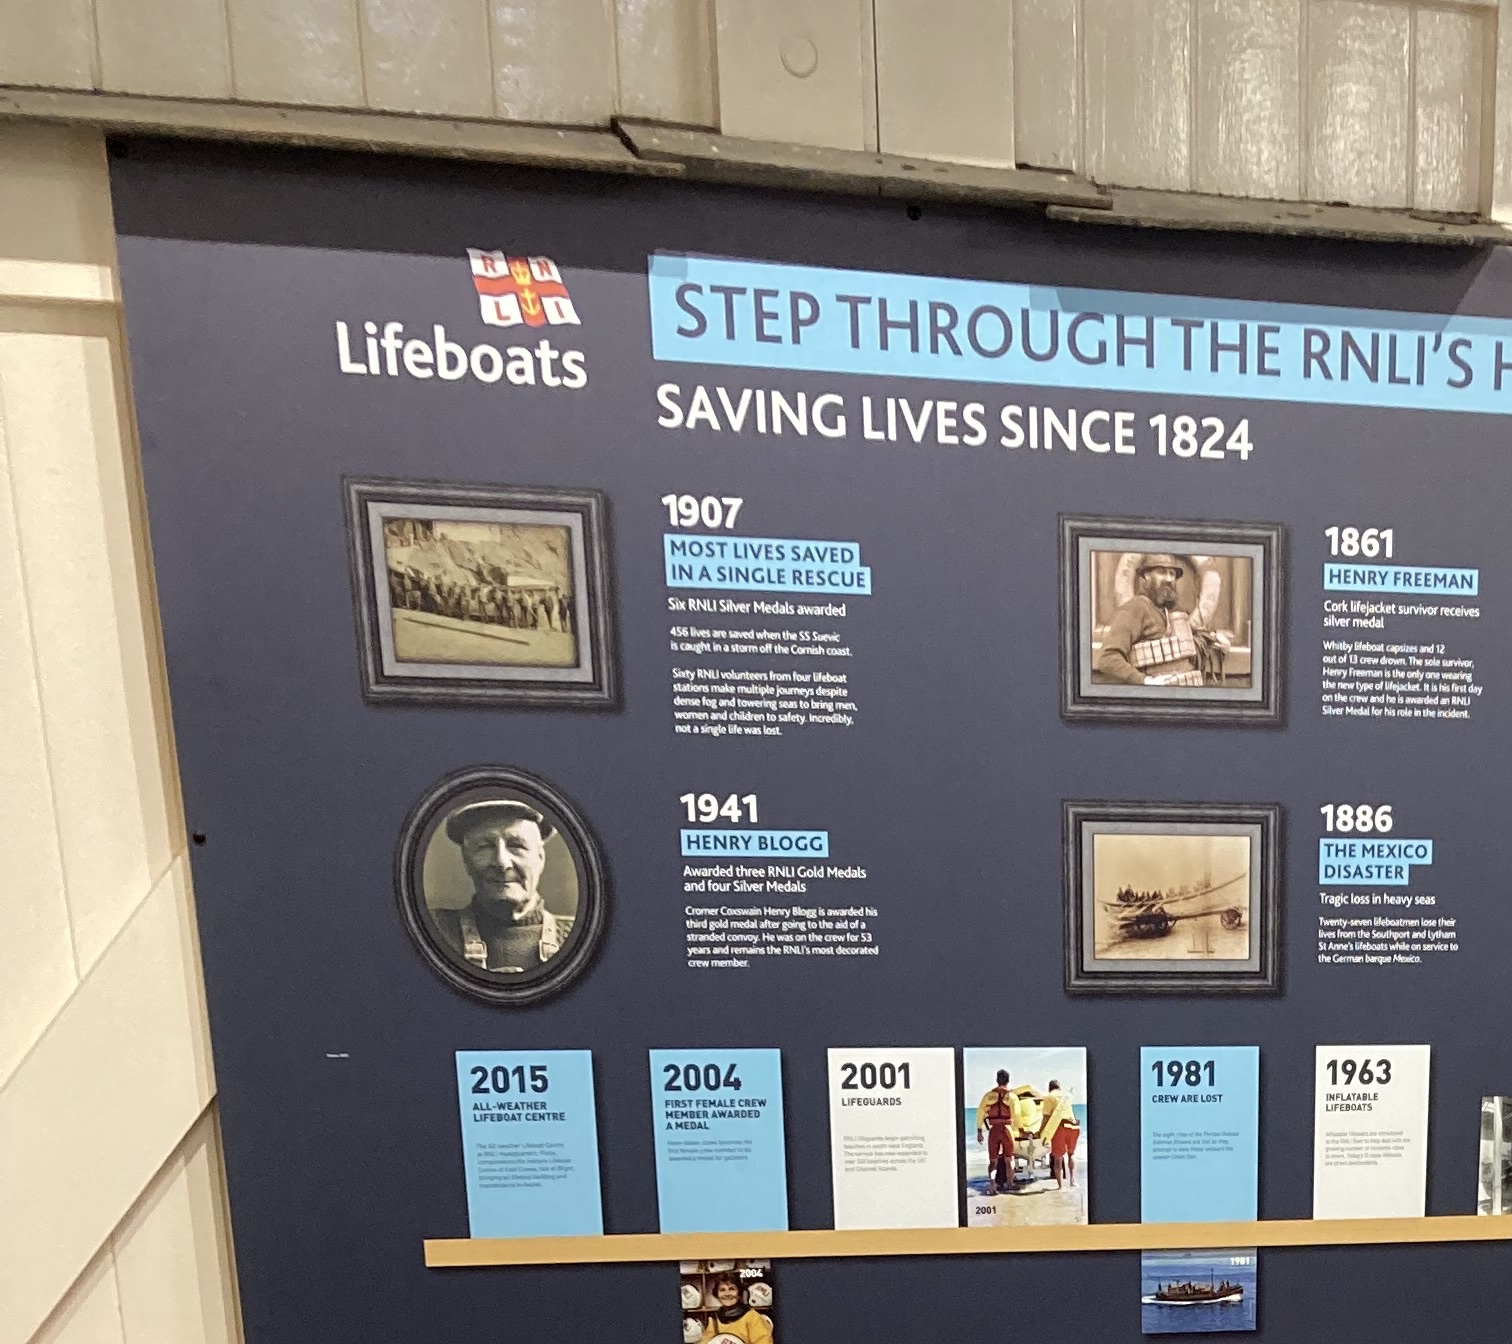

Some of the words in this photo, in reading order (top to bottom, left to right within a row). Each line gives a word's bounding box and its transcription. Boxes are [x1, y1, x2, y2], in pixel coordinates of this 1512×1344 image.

[481, 255, 497, 273] R
[537, 260, 552, 277] N
[495, 301, 511, 321] L
[556, 301, 565, 319] I
[675, 283, 821, 345] STEP
[836, 294, 1156, 370] THROUGH
[1172, 317, 1282, 377] THE
[1301, 327, 1474, 389] RNLI'S
[335, 320, 588, 389] Lifeboats
[655, 383, 846, 439] SAVING
[862, 395, 987, 447] LIVES
[1000, 405, 1136, 455] SINCE
[1149, 414, 1254, 461] 1824
[661, 494, 743, 529] 1907
[1325, 526, 1393, 558] 1861
[670, 540, 728, 558] MOST
[734, 542, 785, 561] LIVES
[791, 547, 854, 564] SAVED
[672, 564, 693, 580] IN
[700, 566, 712, 582] A
[717, 567, 786, 585] SINGLE
[792, 570, 865, 588] RESCUE
[1330, 569, 1389, 586] HENRY
[1394, 571, 1473, 589] FREEMAN
[668, 597, 686, 611] Six
[689, 599, 717, 613] RNLI
[719, 599, 750, 614] Silver
[754, 601, 794, 615] Medals
[797, 603, 846, 617] awarded
[1324, 600, 1348, 613] Cork
[1351, 601, 1396, 616] lifejacket
[1399, 604, 1438, 616] survivor
[1440, 605, 1480, 617] receives
[1324, 616, 1350, 627] silver
[1353, 617, 1384, 629] medal
[670, 627, 688, 637] 456
[691, 627, 710, 638] lives
[712, 631, 727, 639] are
[729, 629, 754, 640] saved
[756, 630, 780, 640] when
[783, 631, 797, 641] the
[799, 631, 810, 641] SS
[812, 632, 840, 642] Suevic
[1323, 640, 1351, 652] Whitby
[1354, 641, 1384, 652] lifeboat
[1386, 644, 1417, 655] capsizes
[1420, 644, 1434, 653] and
[1436, 644, 1445, 654] 12
[680, 793, 758, 823] 1941
[1320, 804, 1392, 832] 1886
[687, 835, 752, 850] HENRY
[759, 836, 823, 851] BLOGG
[1324, 843, 1356, 858] THE
[1362, 844, 1427, 859] MEXICO
[684, 865, 733, 877] Awarded
[736, 865, 765, 878] three
[768, 866, 794, 878] RNLI
[797, 866, 824, 878] Gold
[827, 866, 866, 879] Medals
[1325, 864, 1404, 879] DISASTER
[684, 880, 705, 892] and
[708, 880, 731, 892] four
[733, 880, 764, 892] Silver
[766, 881, 806, 893] Medals
[1320, 893, 1348, 907] Tragic
[1351, 893, 1369, 905] loss
[1372, 894, 1381, 905] in
[1384, 894, 1412, 908] heavy
[1415, 896, 1435, 905] seas
[685, 906, 719, 916] Cromer
[721, 906, 762, 916] Coxswain
[764, 907, 790, 918] Henry
[792, 906, 817, 919] Blogg
[818, 907, 825, 916] is
[827, 907, 864, 917] awarded
[866, 907, 878, 917] his
[470, 1066, 548, 1094] 2015
[663, 1063, 742, 1091] 2004
[841, 1062, 911, 1090] 2001
[1152, 1060, 1214, 1087] 1981
[1326, 1059, 1392, 1086] 1963
[665, 1100, 693, 1108] FIRST
[696, 1099, 735, 1108] FEMALE
[738, 1099, 767, 1107] CREW
[842, 1097, 902, 1107] LIFEGUARDS
[1152, 1095, 1179, 1103] CREW
[1181, 1095, 1198, 1103] ARE
[1201, 1094, 1223, 1103] LOST
[1325, 1092, 1379, 1101] INFLATABLE
[473, 1101, 547, 1111] ALL-WEATHER
[1325, 1103, 1373, 1112] LIFEBOATS
[473, 1113, 522, 1122] LIFEBOAT
[525, 1112, 566, 1121] CENTRE
[666, 1111, 709, 1119] MEMBER
[711, 1110, 760, 1118] AWARDED
[666, 1122, 673, 1130] A
[675, 1121, 709, 1130] MEDAL
[975, 1206, 997, 1215] 2001
[1230, 1256, 1250, 1266] 1981
[740, 1269, 763, 1278] 2004
